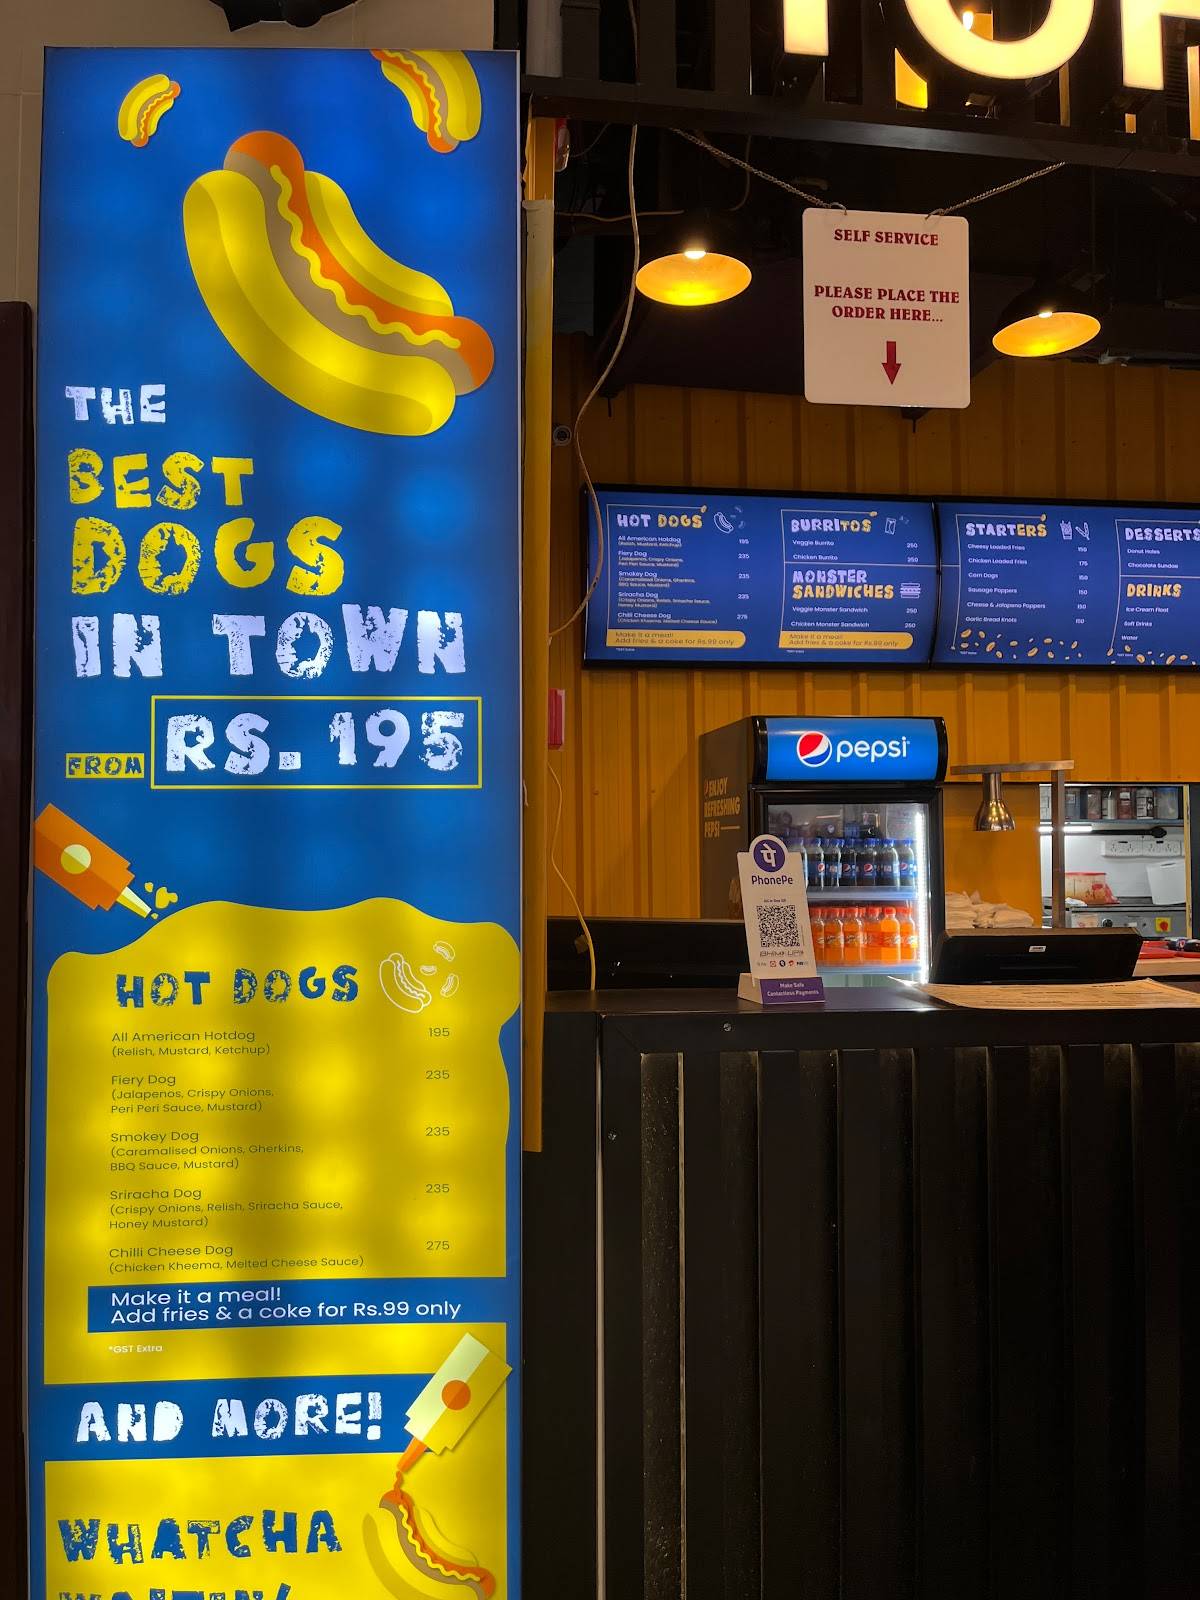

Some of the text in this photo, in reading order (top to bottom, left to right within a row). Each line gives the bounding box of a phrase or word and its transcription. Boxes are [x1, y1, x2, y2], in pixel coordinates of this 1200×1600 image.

[834, 229, 938, 246] SELF SERVICE
[814, 285, 960, 304] PLEASE PLACE THE
[832, 306, 943, 322] ORDER HERE...
[65, 384, 166, 425] THE
[68, 448, 254, 510] BEST
[616, 514, 702, 528] HOT DOGS
[791, 518, 872, 532] BURRITOS
[966, 522, 1047, 537] STARTERS
[1125, 527, 1200, 542] DESSERTS
[71, 515, 345, 596] DOGS
[792, 569, 867, 584] MONSTER
[792, 584, 894, 600] SANDWICHES
[1126, 583, 1182, 598] DRINKS
[71, 603, 466, 679] IN TOWN
[69, 709, 465, 775] FROM RS. 195
[836, 736, 907, 762] pepsi
[704, 796, 740, 818] REFRESHING
[752, 875, 793, 885] PhonePe
[116, 964, 359, 1008] HOT DOGS
[112, 1030, 256, 1042] All American Hotdog
[428, 1027, 450, 1038] 195
[112, 1044, 270, 1058] (Relish, Mustard, Ketchup)
[111, 1074, 176, 1087] Fiery Dog
[426, 1070, 450, 1080] 235
[112, 1088, 274, 1101] (Jalapenos, Crispy Onions,
[111, 1101, 262, 1114] Peri Peri Sauce, Mustard)
[111, 1131, 199, 1144] Smokey Dog
[426, 1126, 450, 1137] 235
[111, 1144, 304, 1158] (Caramalised Onions, Gherkins,
[110, 1158, 240, 1172] BBQ Sauce, Mustard)
[110, 1188, 202, 1200] Sriracha Dog
[426, 1183, 450, 1194] 235
[110, 1200, 344, 1216] (Crispy Onions, Relish, Sriracha Sauce,
[110, 1216, 209, 1230] Honey Mustard)
[110, 1244, 233, 1258] Chilli Cheese Dog
[426, 1240, 450, 1251] 275
[110, 1256, 364, 1274] (Chicken Kheema, Melted Cheese Sauce)
[111, 1286, 282, 1306] Make it a meal!
[110, 1300, 462, 1324] Add fries & a coke for Rs.99 only
[136, 1344, 163, 1353] Extra
[76, 1392, 382, 1442] AND MORE!
[57, 1510, 343, 1565] WHATCHA
